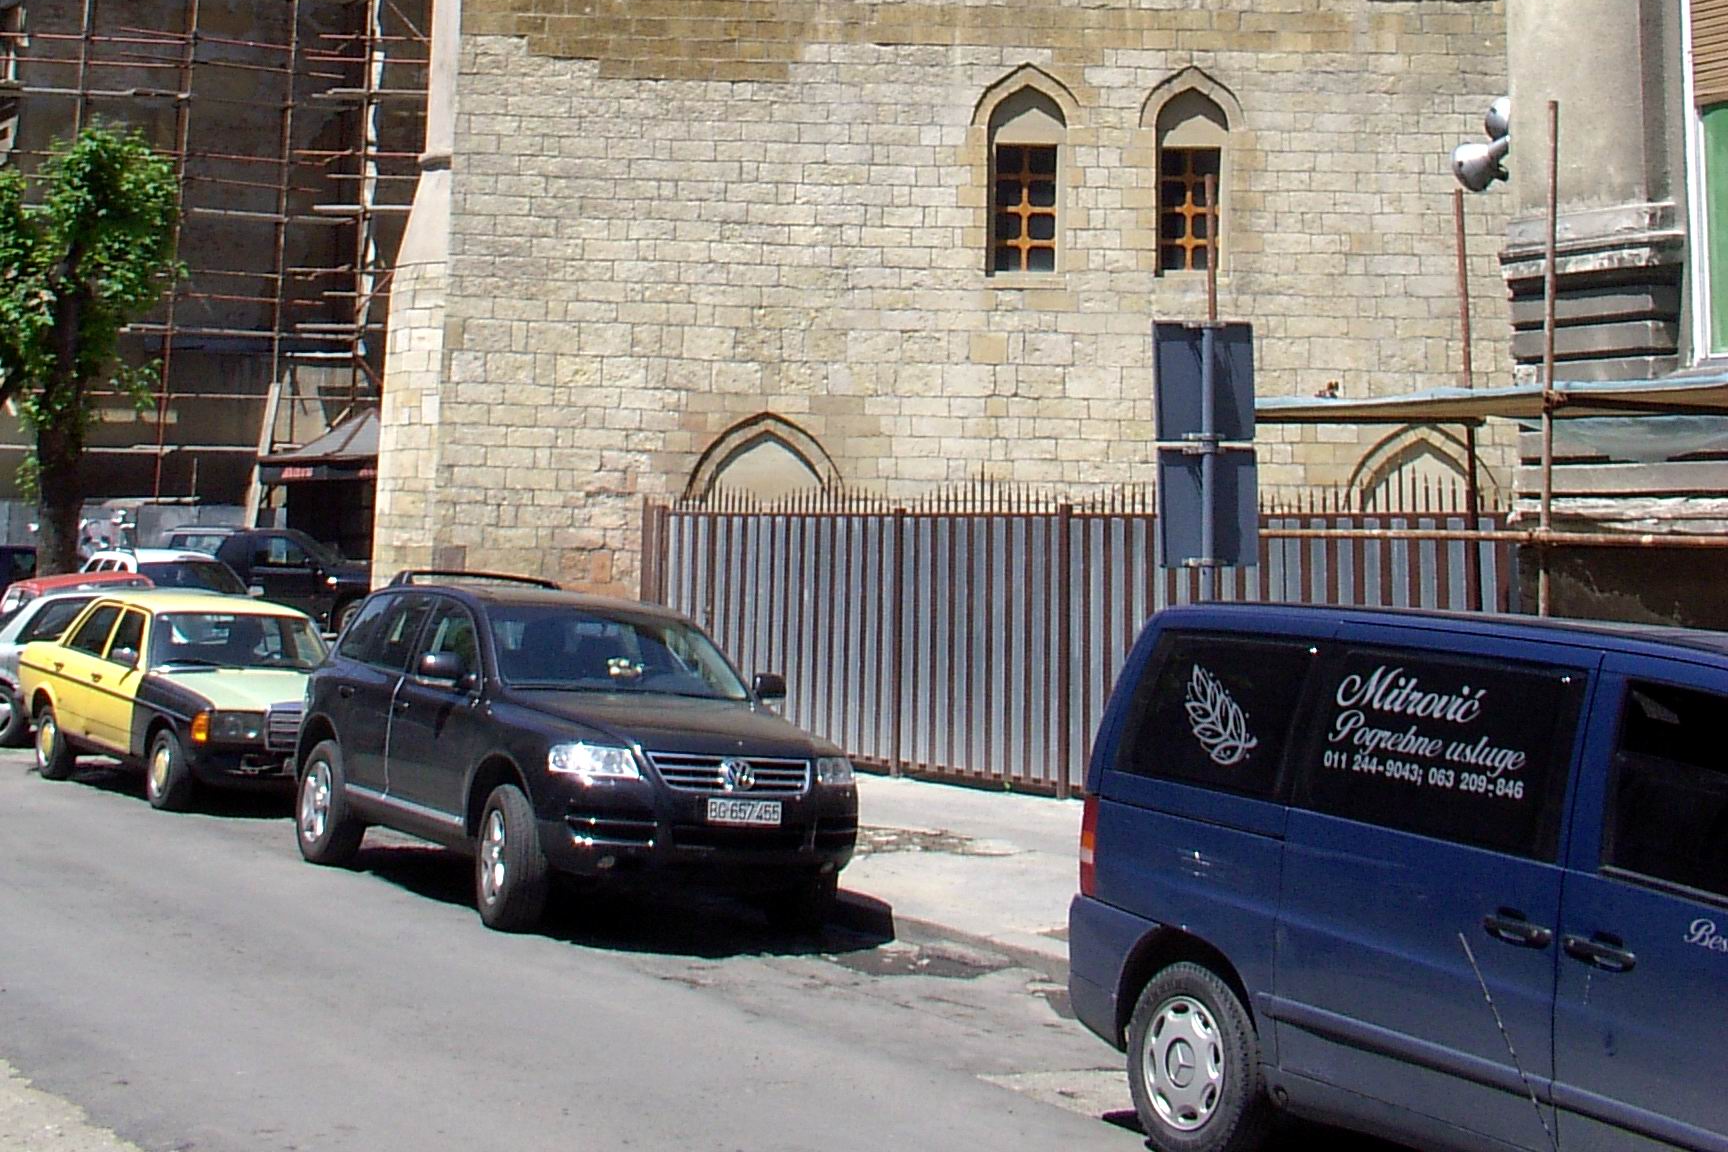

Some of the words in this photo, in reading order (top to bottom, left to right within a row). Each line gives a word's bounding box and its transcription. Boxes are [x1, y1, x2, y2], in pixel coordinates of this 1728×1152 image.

[1336, 665, 1487, 723] Mitrović
[1323, 750, 1348, 769] 011
[1428, 767, 1454, 788] 063
[1328, 710, 1443, 757] Pogrebne
[1445, 736, 1526, 777] usluge
